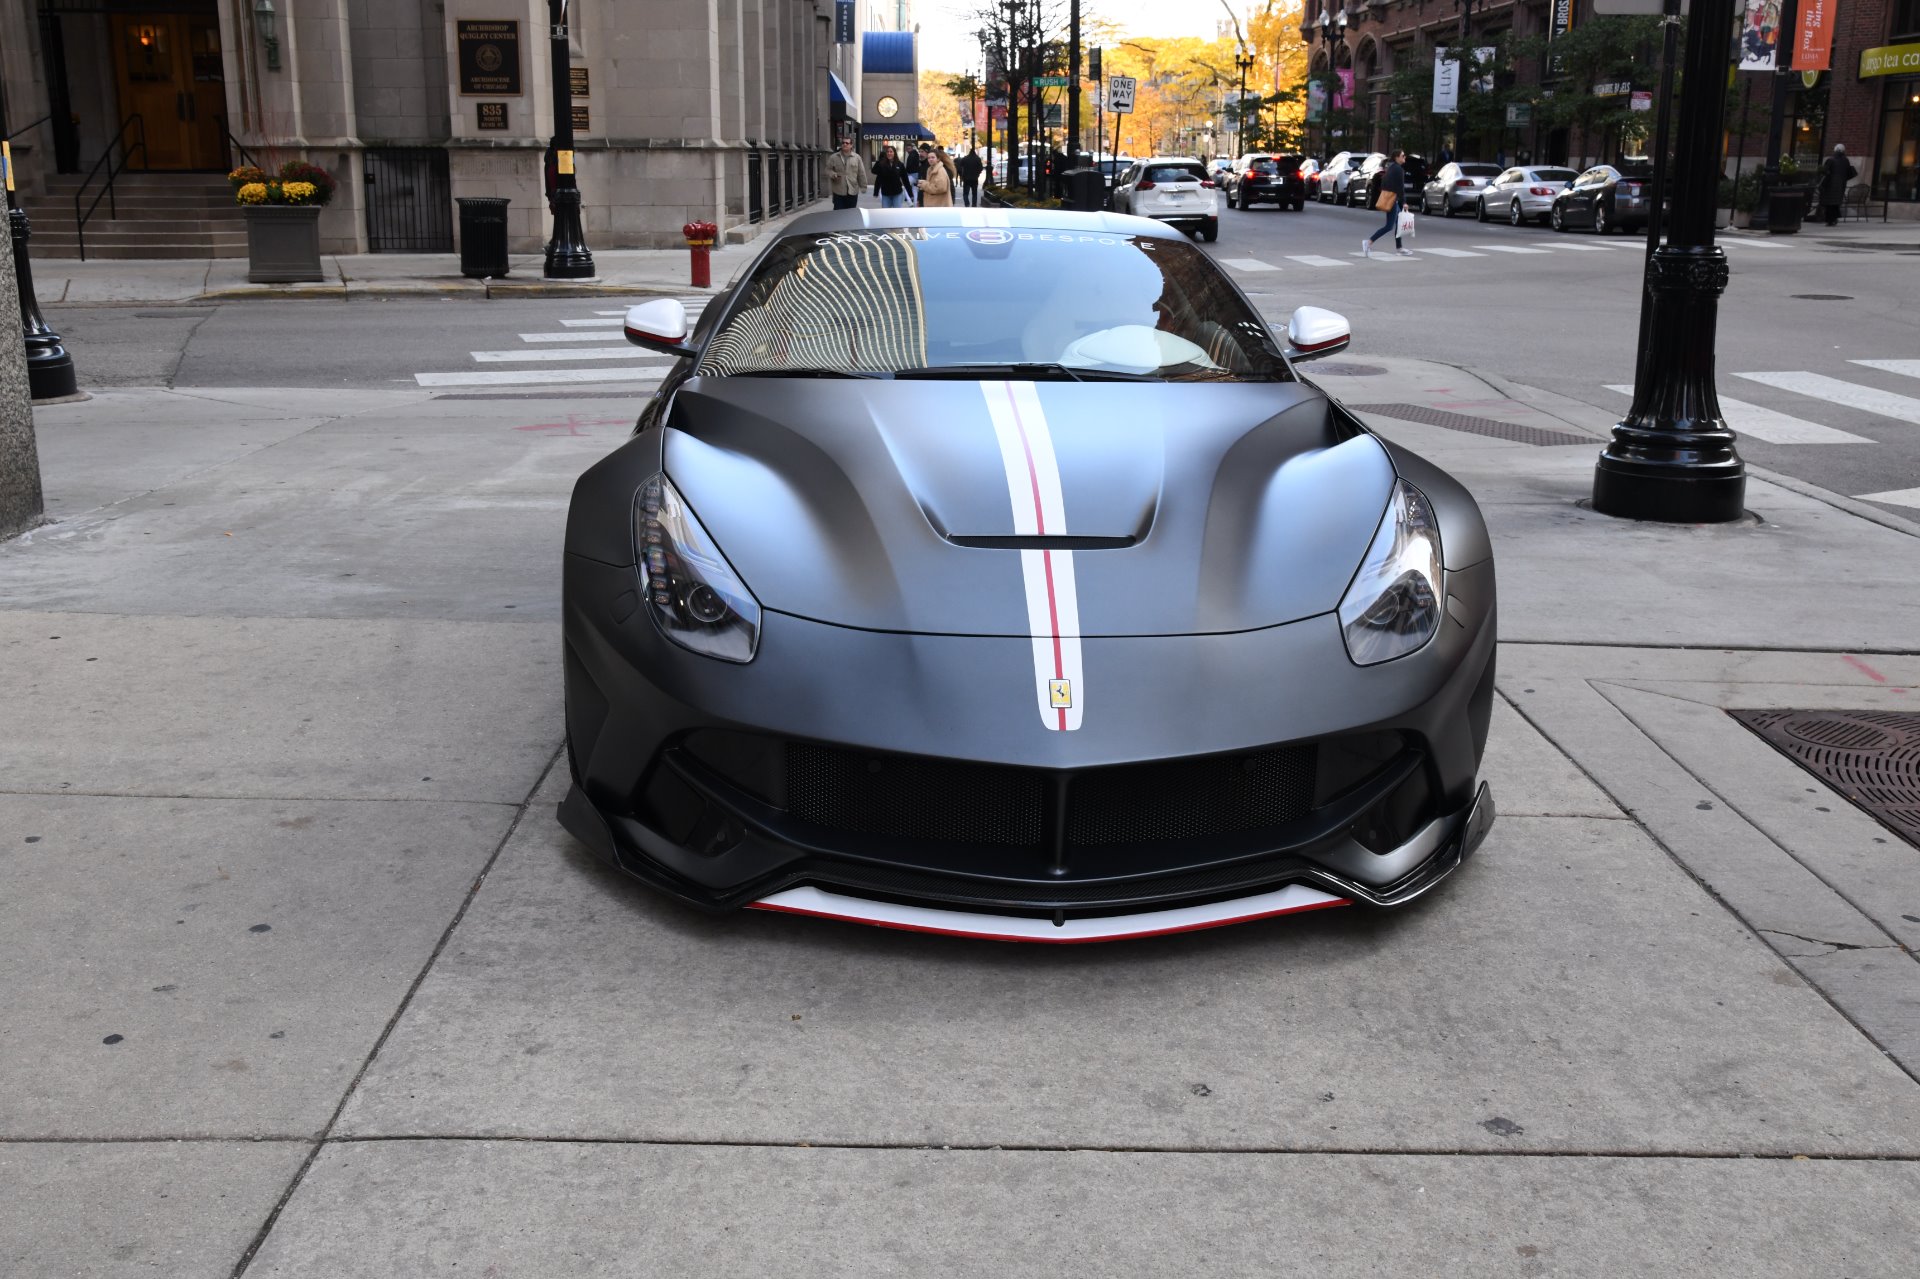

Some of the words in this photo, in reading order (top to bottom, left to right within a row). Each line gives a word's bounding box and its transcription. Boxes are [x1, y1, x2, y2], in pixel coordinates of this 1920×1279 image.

[1805, 10, 1815, 27] the
[1803, 30, 1813, 51] Box
[1884, 53, 1899, 69] tea
[1113, 79, 1133, 89] ONE
[1112, 90, 1132, 99] WAY
[482, 105, 502, 115] 835
[815, 232, 961, 245] CREATIVE
[1018, 233, 1156, 251] BESPOKE
